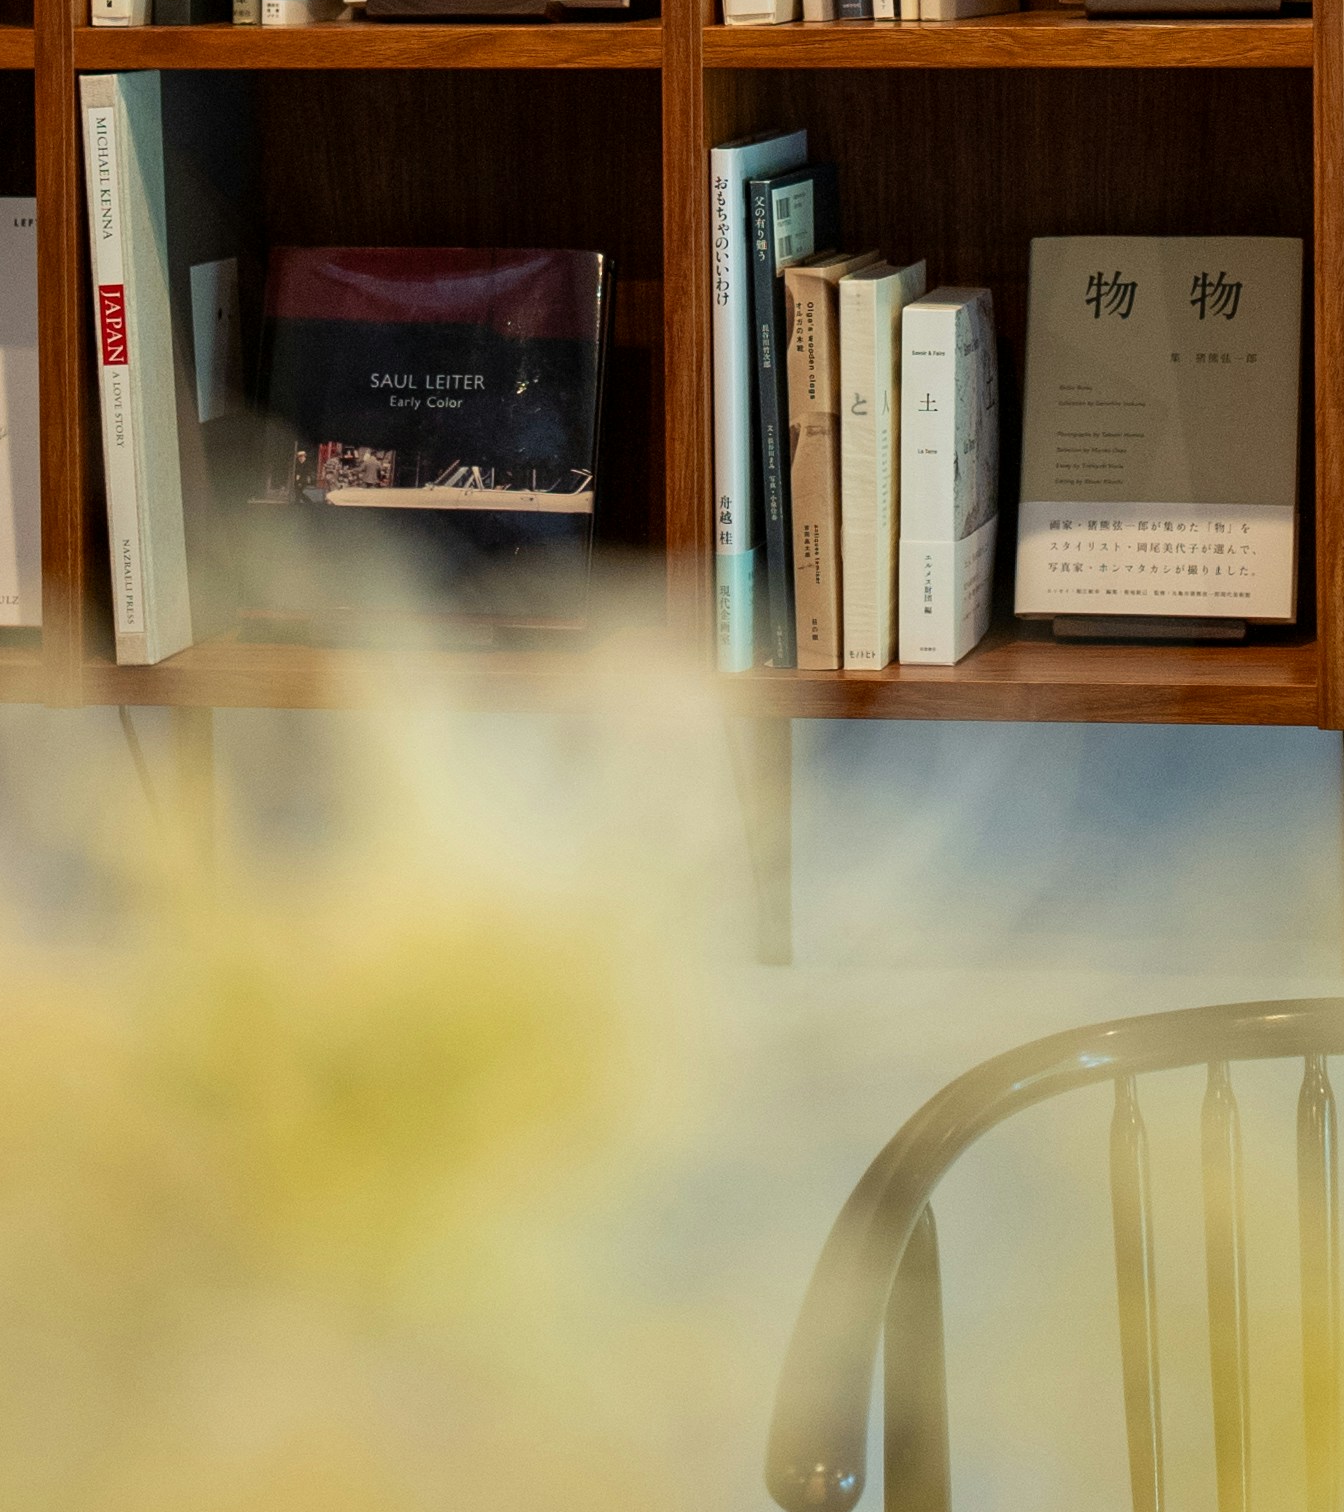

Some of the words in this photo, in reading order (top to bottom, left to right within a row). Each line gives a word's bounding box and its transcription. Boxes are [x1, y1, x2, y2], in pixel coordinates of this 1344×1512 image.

[96, 117, 111, 184] MICHAEL
[100, 188, 113, 241] KENNA
[754, 196, 768, 263] 父の有り難う
[714, 177, 730, 307] おもちゃのいいわけ
[1085, 270, 1138, 320] 物
[1190, 271, 1243, 321] 物
[101, 290, 126, 363] JAPAN
[806, 301, 814, 332] Olga's
[807, 334, 815, 371] wooden
[113, 381, 122, 410] LOVE
[370, 373, 417, 389] SAUL
[426, 374, 486, 390] LEITER
[808, 373, 816, 401] clogs
[389, 395, 421, 411] Early
[426, 396, 463, 408] Color
[850, 392, 868, 416] と
[115, 413, 125, 449] STORY
[924, 554, 933, 603] エルメス財団
[126, 594, 135, 625] PRESS
